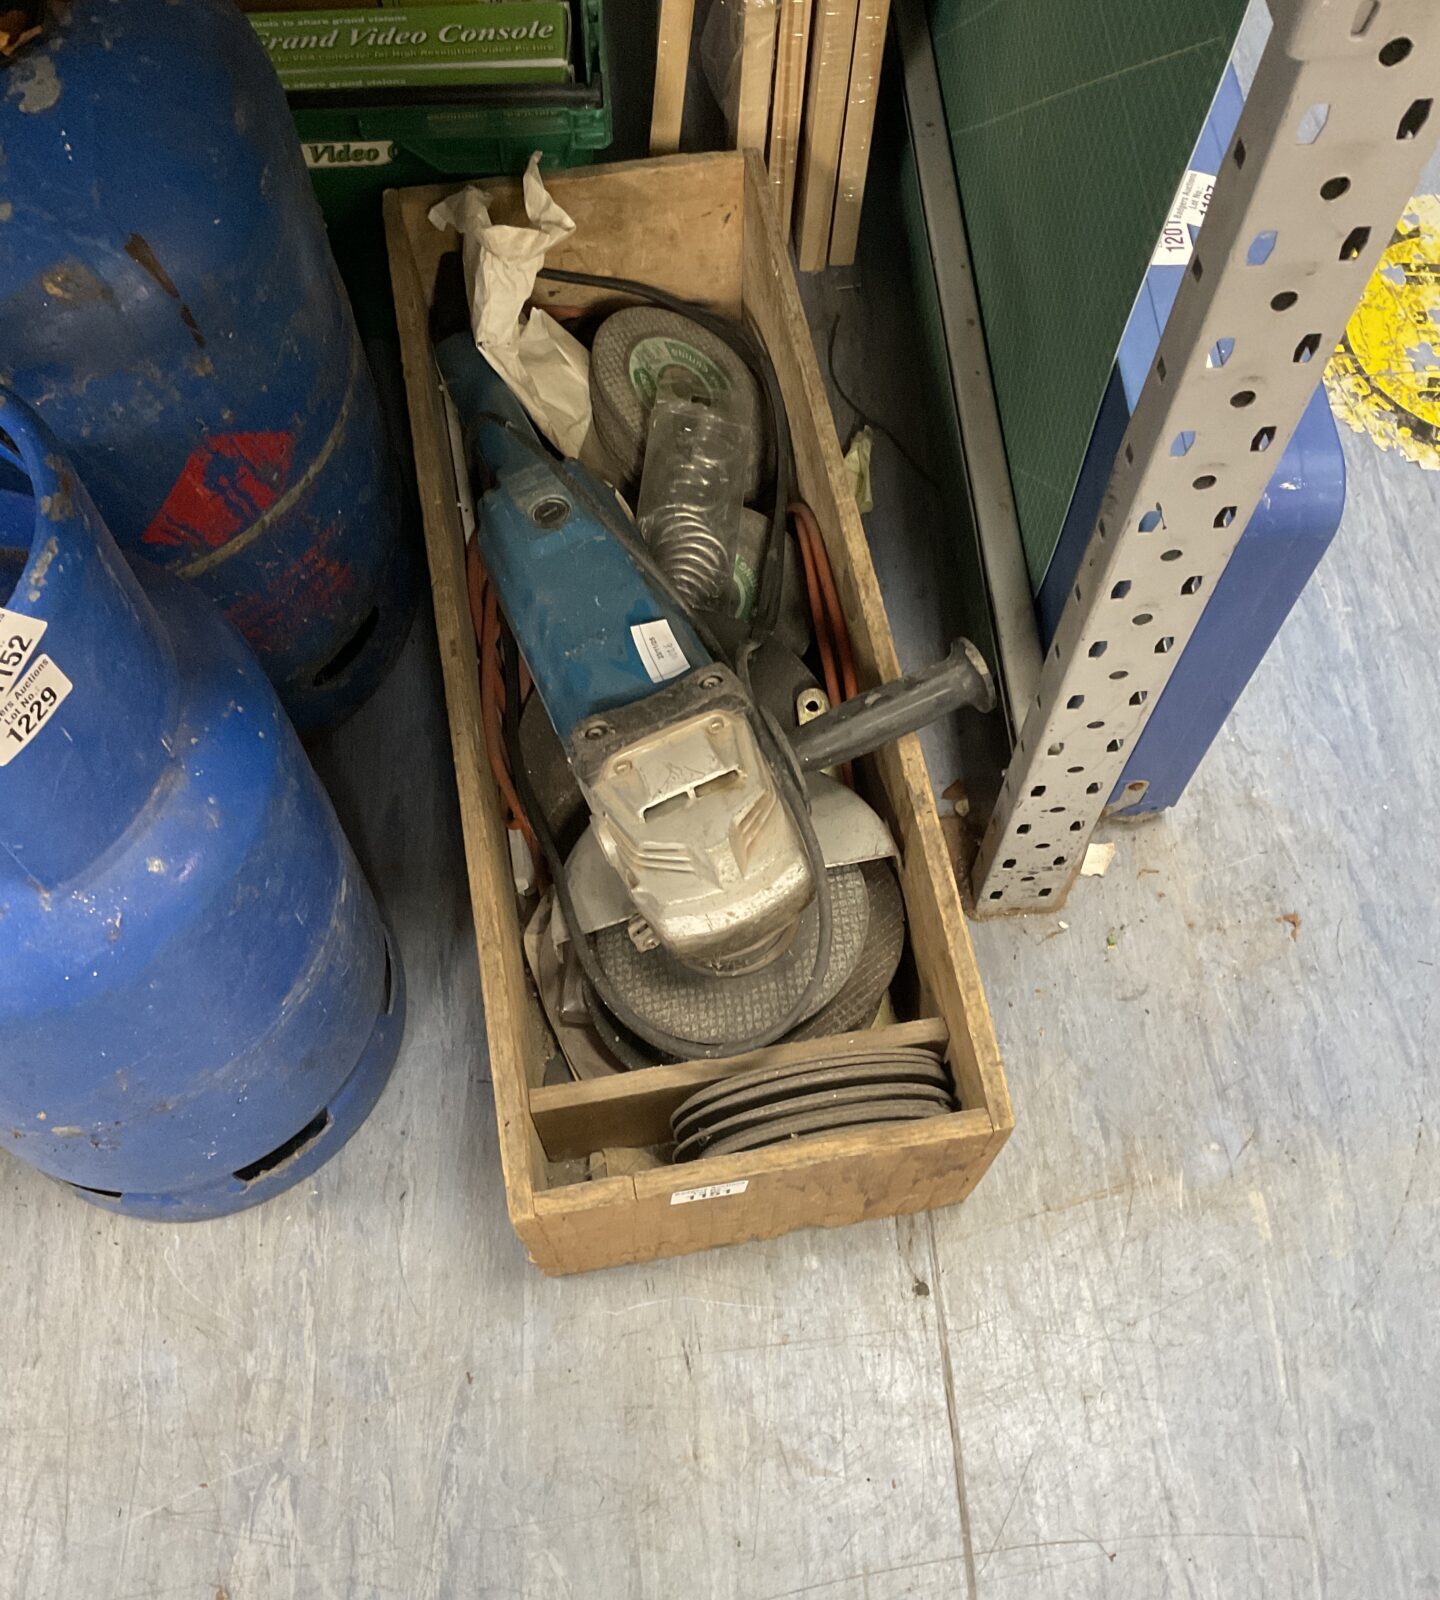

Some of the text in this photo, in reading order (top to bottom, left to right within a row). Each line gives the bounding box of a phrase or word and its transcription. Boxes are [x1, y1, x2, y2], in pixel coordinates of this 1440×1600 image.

[298, 18, 329, 26] share
[332, 16, 365, 25] grand
[367, 14, 408, 23] visions
[350, 26, 428, 48] Video
[438, 20, 554, 43] Console
[420, 47, 478, 56] Resolution
[481, 45, 512, 54] Video
[515, 44, 554, 52] Picture
[329, 79, 363, 88] grand
[366, 77, 406, 86] visions
[307, 144, 380, 163] Video
[14, 658, 49, 701] Auctions
[5, 709, 21, 725] Lot
[6, 686, 58, 743] 1229
